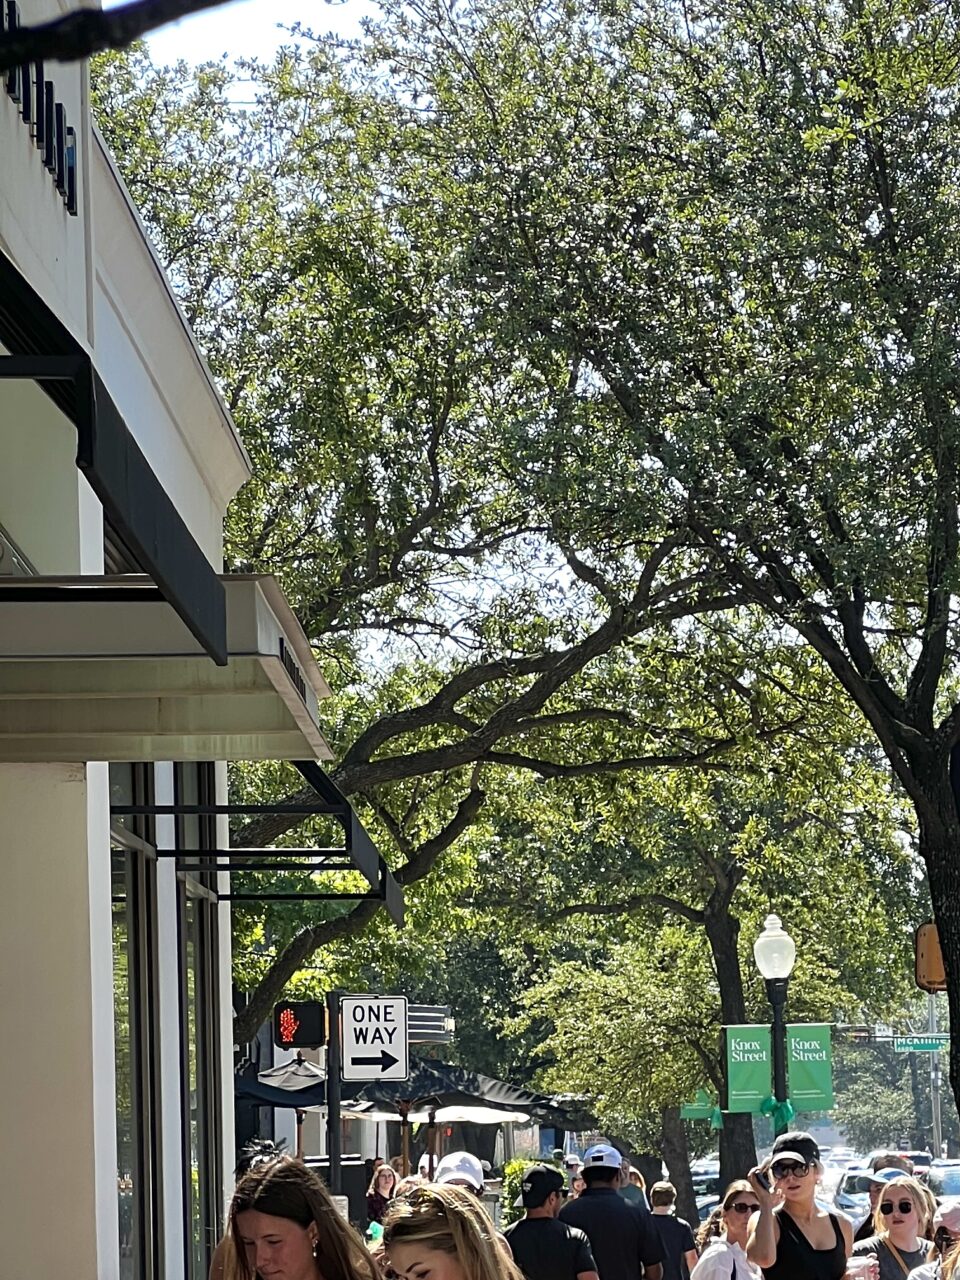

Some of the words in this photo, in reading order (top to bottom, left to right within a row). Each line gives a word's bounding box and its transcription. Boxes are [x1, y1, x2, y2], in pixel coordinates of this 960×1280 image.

[352, 1004, 396, 1023] ONE
[353, 1026, 398, 1045] WAY
[731, 1038, 761, 1051] Knox
[791, 1037, 821, 1050] Knox
[731, 1050, 768, 1063] Street
[791, 1049, 828, 1062] Street
